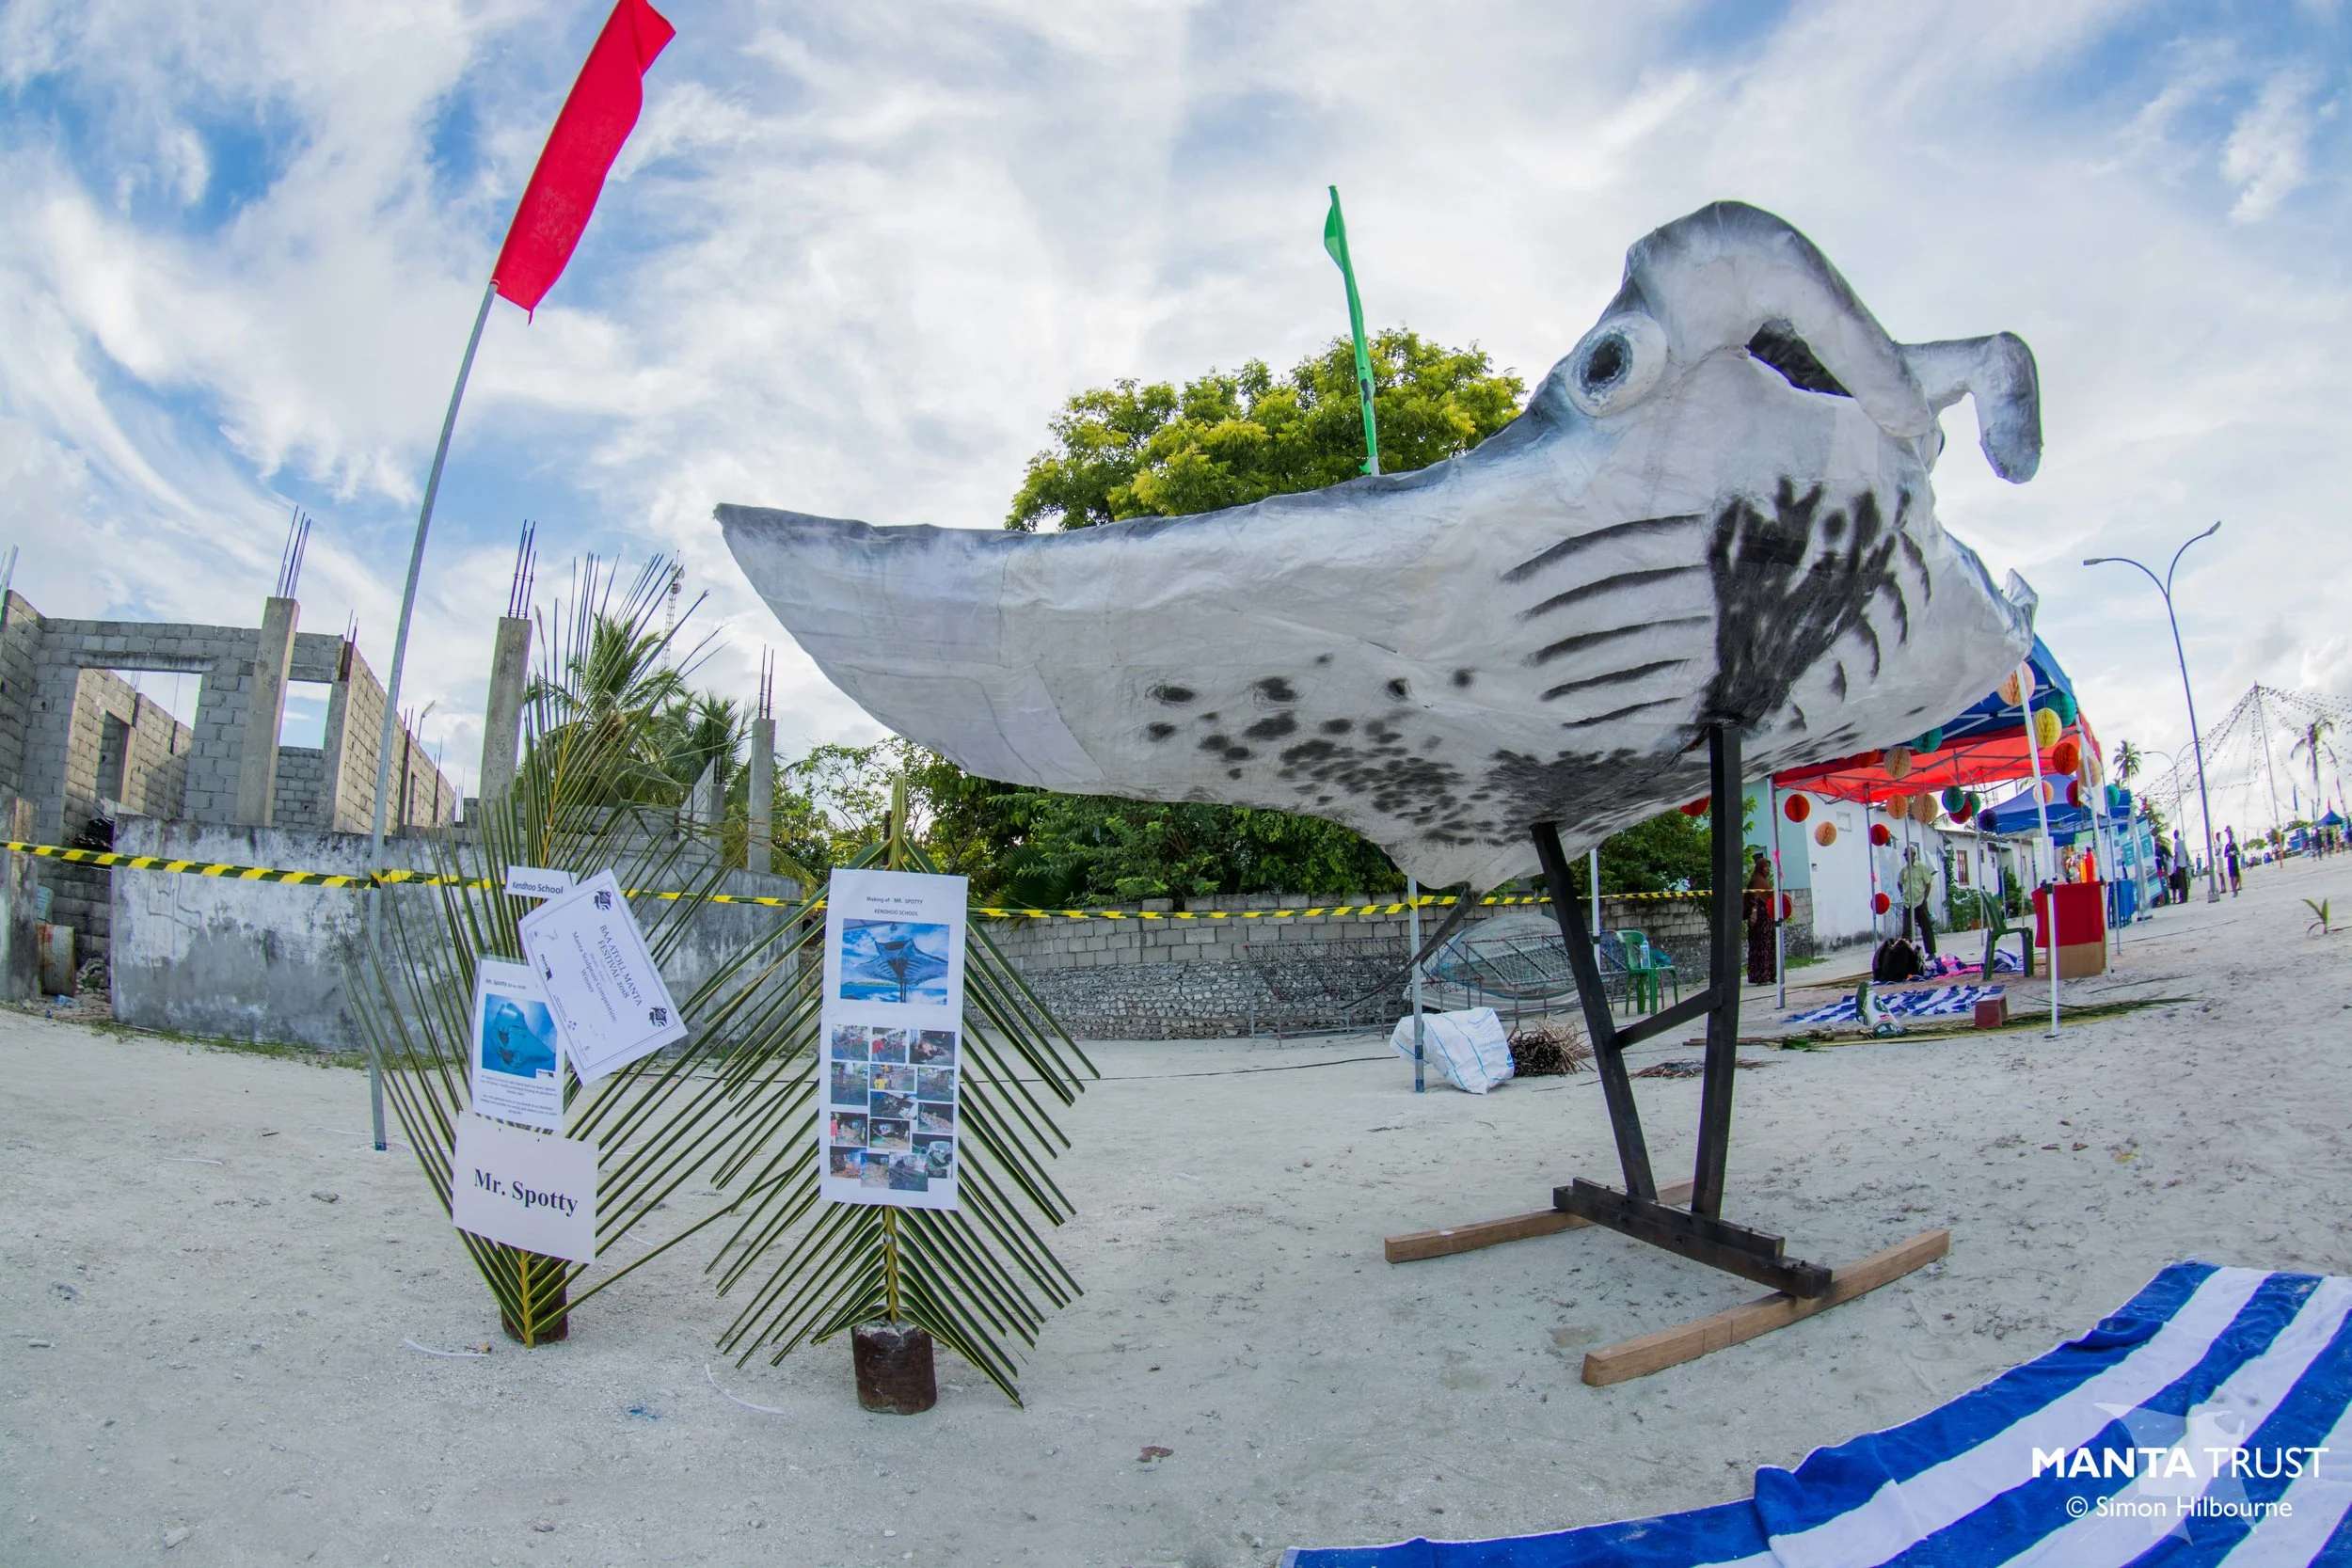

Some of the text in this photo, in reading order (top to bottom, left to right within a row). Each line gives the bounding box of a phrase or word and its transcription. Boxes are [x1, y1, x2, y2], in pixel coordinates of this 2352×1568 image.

[512, 880, 564, 895] Kendhoo School
[572, 931, 584, 953] Manta
[582, 952, 598, 982] Sculpture
[580, 969, 595, 993] Winner
[597, 940, 621, 980] FESTIVAL
[616, 981, 630, 999] 2018
[599, 925, 612, 944] BAA
[609, 944, 627, 972] ATOLL
[623, 973, 643, 1006] MANTA
[474, 1168, 578, 1217] Mr. Spotty
